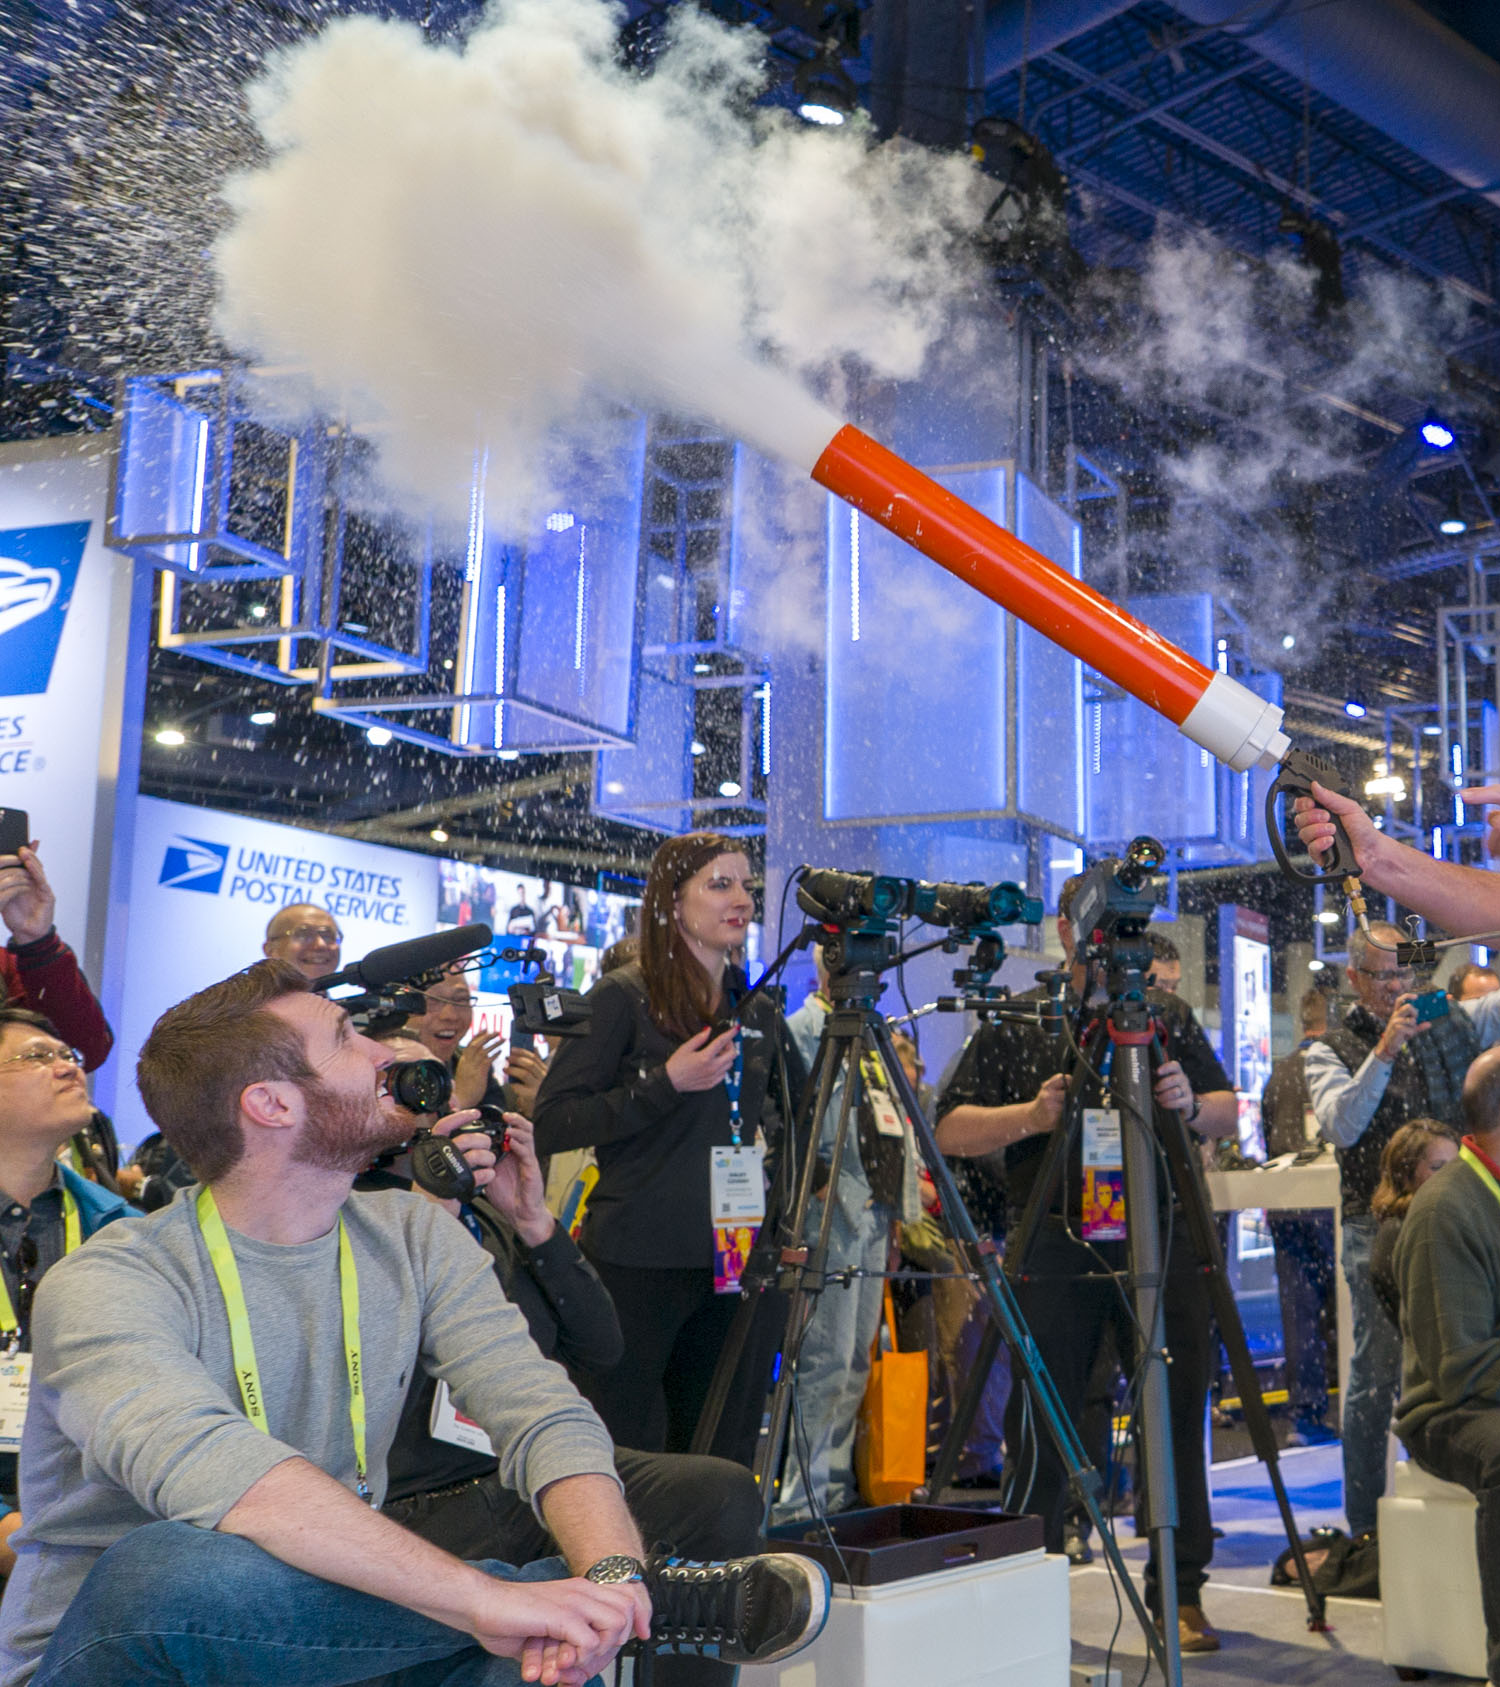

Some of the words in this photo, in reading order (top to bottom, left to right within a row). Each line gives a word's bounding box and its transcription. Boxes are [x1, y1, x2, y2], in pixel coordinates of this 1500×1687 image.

[236, 847, 326, 885] UNITED
[328, 866, 403, 899] STATES
[442, 1145, 464, 1174] Canon
[241, 1369, 260, 1417] SONY
[349, 1349, 360, 1396] SONY
